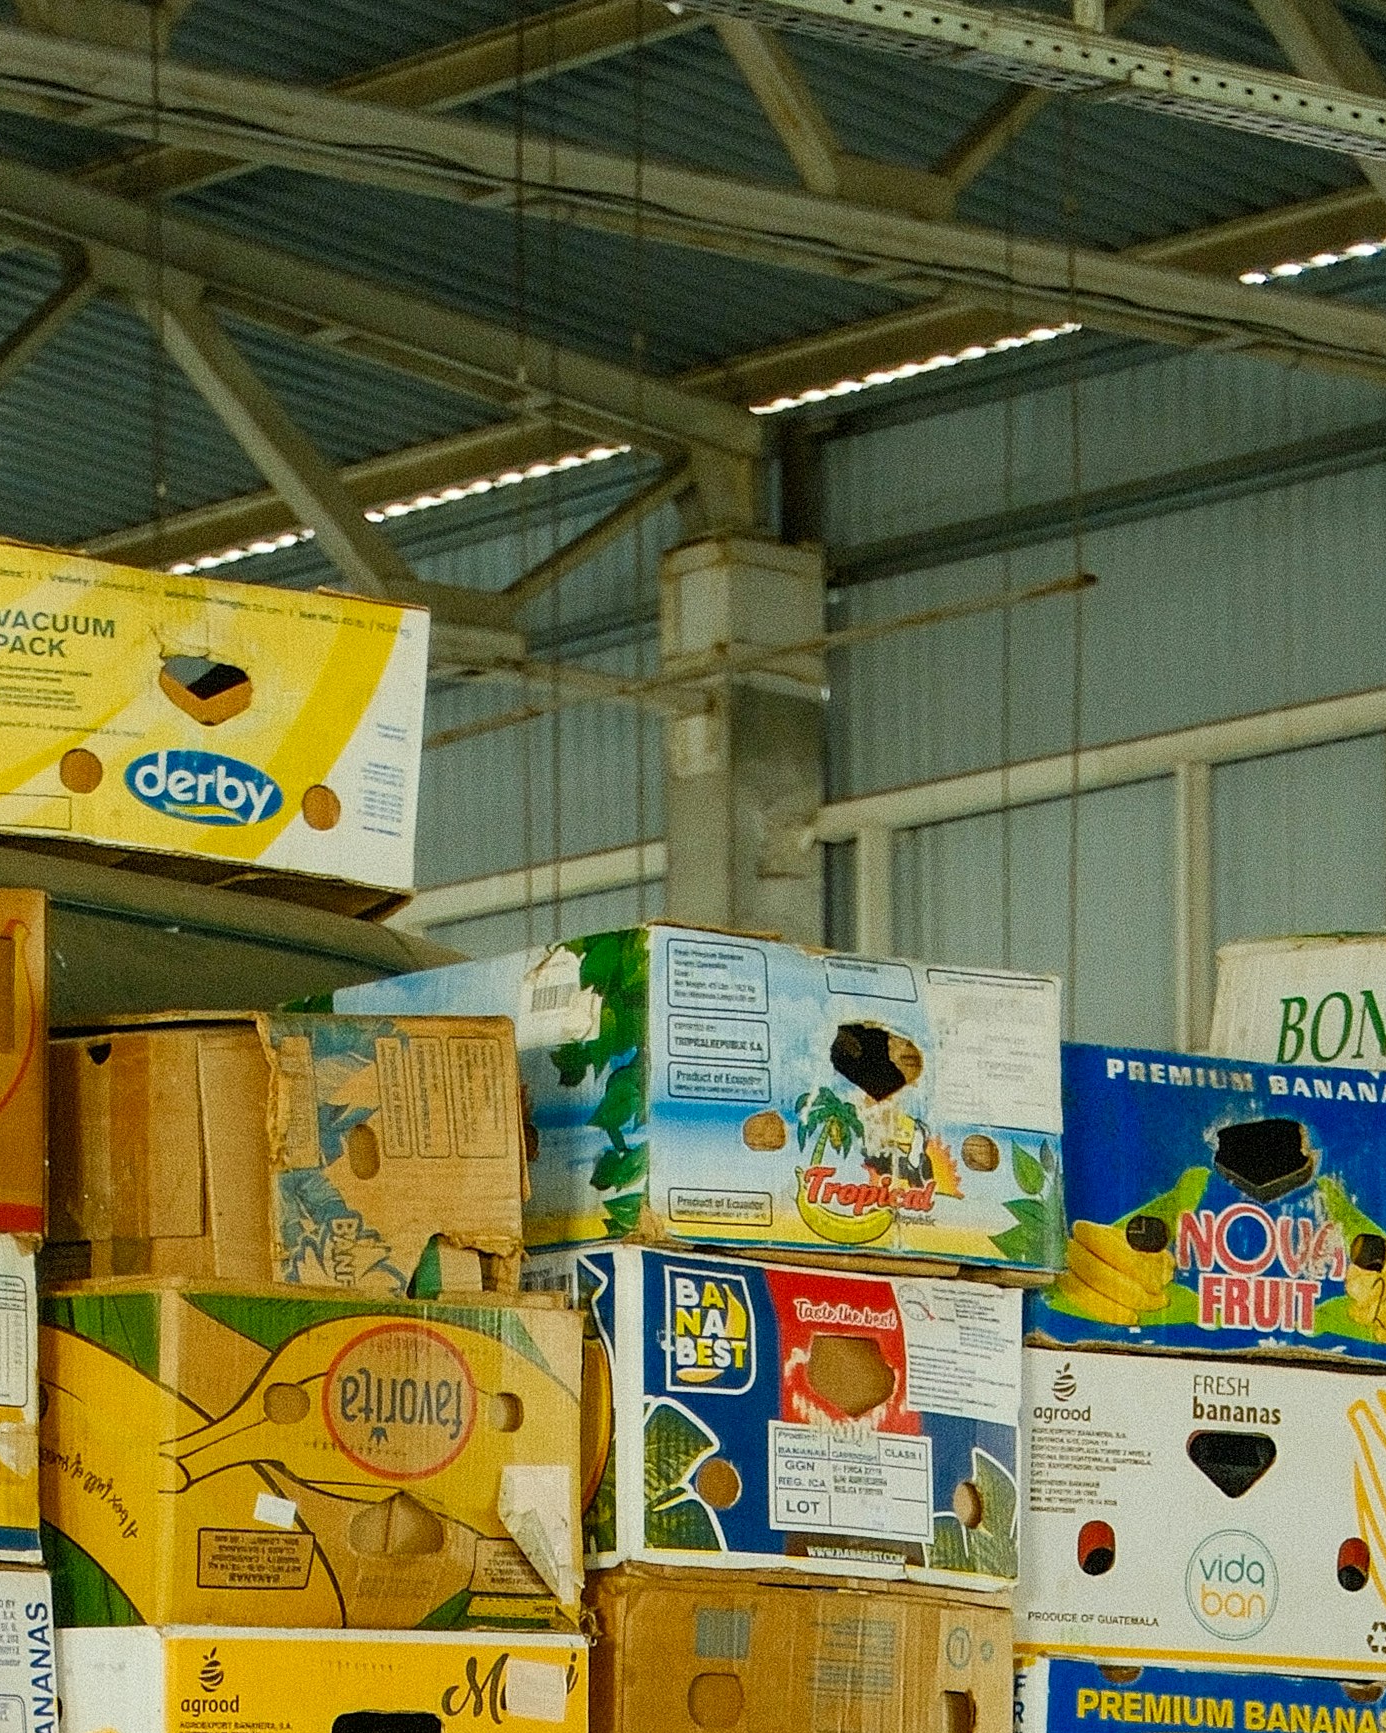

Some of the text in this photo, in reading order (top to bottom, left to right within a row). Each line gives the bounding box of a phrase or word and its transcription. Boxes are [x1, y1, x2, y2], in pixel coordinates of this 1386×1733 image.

[134, 754, 276, 823] derby
[1106, 1058, 1254, 1093] PREMIUM
[805, 1166, 935, 1216] Tropical
[1177, 1203, 1346, 1280] NOVA
[1198, 1276, 1322, 1334] FRUIT
[675, 1337, 747, 1369] BEST
[1193, 1374, 1250, 1397] FRESH
[341, 1369, 462, 1439] favorita
[1033, 1404, 1091, 1423] agrood
[1191, 1399, 1282, 1426] bananas
[784, 1460, 816, 1473] GGN
[786, 1500, 820, 1516] LOT
[1199, 1554, 1265, 1588] vida
[181, 1696, 240, 1717] agrood
[1076, 1688, 1235, 1730] PREMIUM
